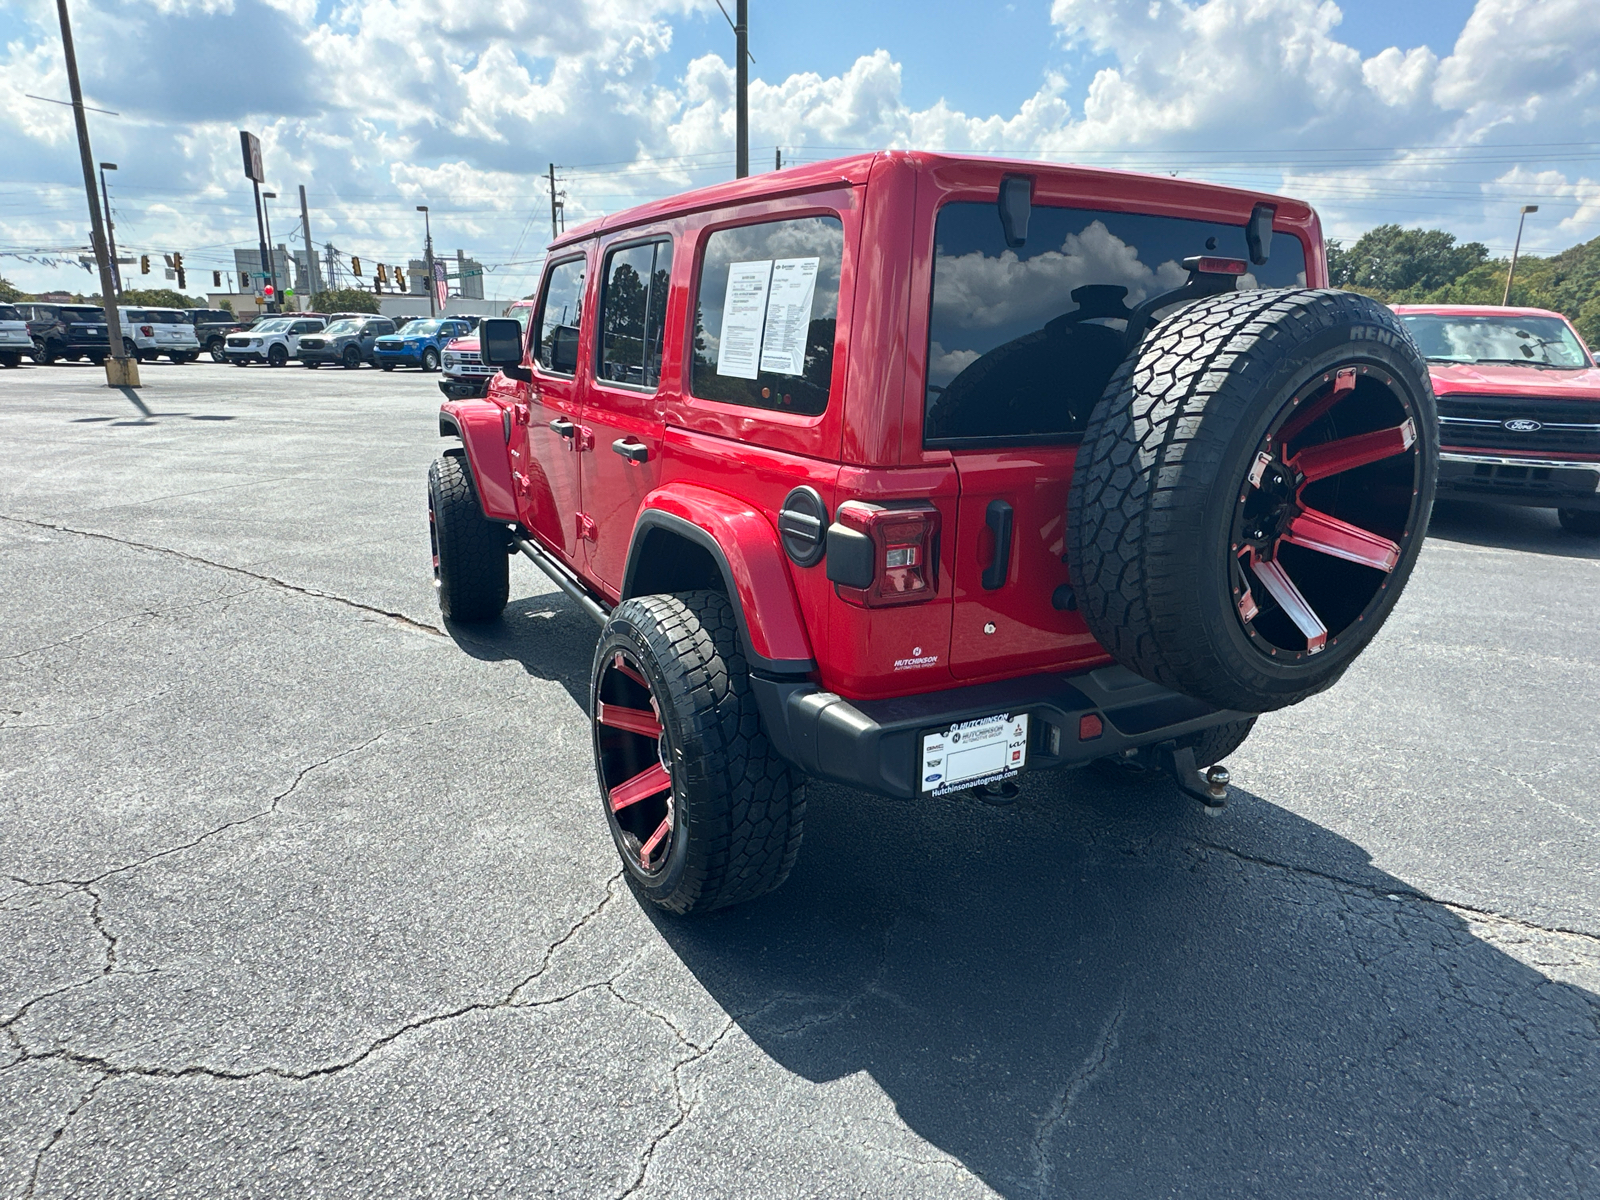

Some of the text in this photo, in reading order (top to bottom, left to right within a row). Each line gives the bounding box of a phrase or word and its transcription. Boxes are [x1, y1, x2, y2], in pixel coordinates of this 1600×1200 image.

[1510, 420, 1535, 430] Ford
[894, 656, 938, 667] HUTCHINSON
[960, 713, 1009, 731] HUTCHINSON
[962, 725, 1004, 740] HUTCHINSON
[926, 743, 944, 751] GMC
[1009, 739, 1026, 749] KIA
[926, 774, 942, 782] Ford
[932, 770, 1018, 797] Hutchinsonautogroup.com
